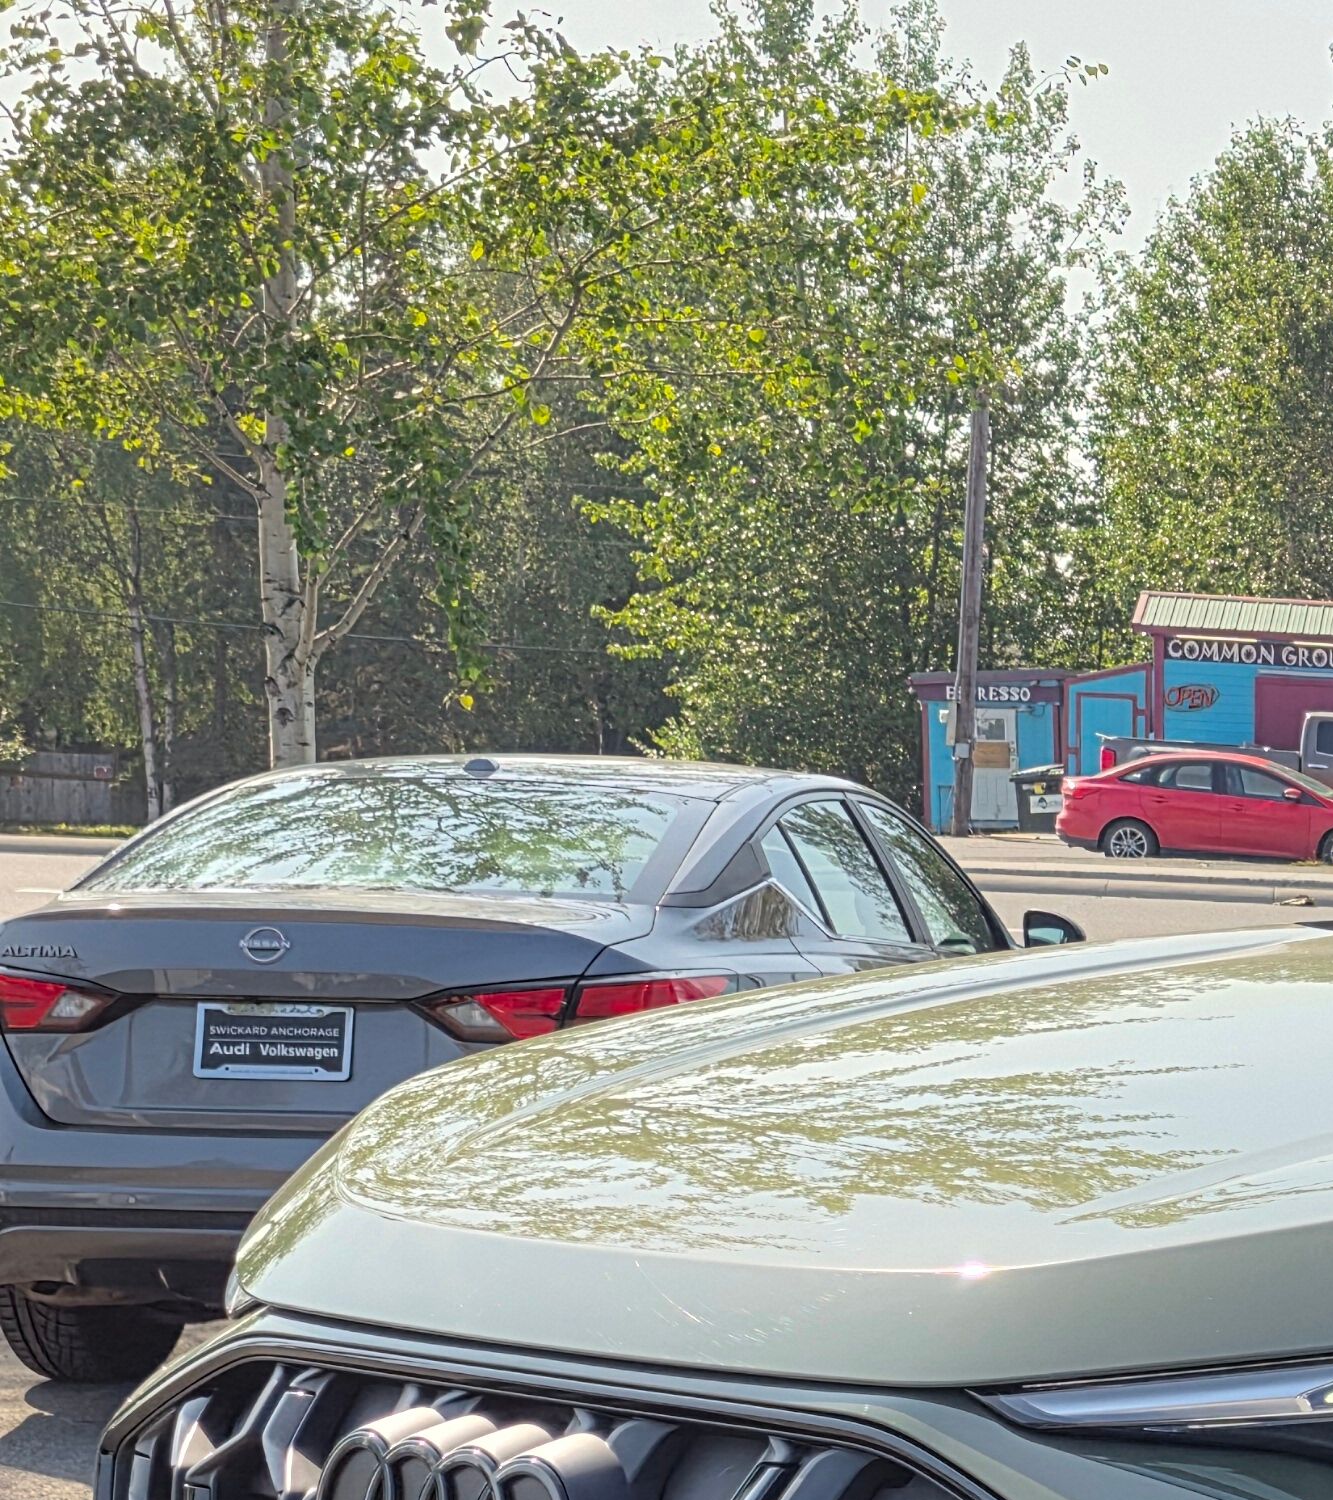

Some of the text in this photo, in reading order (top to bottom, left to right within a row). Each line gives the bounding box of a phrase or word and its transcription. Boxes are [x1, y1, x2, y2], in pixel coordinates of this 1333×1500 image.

[1168, 638, 1275, 665] COMMON
[946, 685, 1031, 702] ERESSO
[1166, 687, 1215, 707] OPEN
[2, 944, 79, 959] ALTIMA
[239, 938, 291, 950] NISSAN
[209, 1025, 340, 1037] SWICKARD ANCHORAGE
[209, 1042, 338, 1060] Audi Volkswagen
